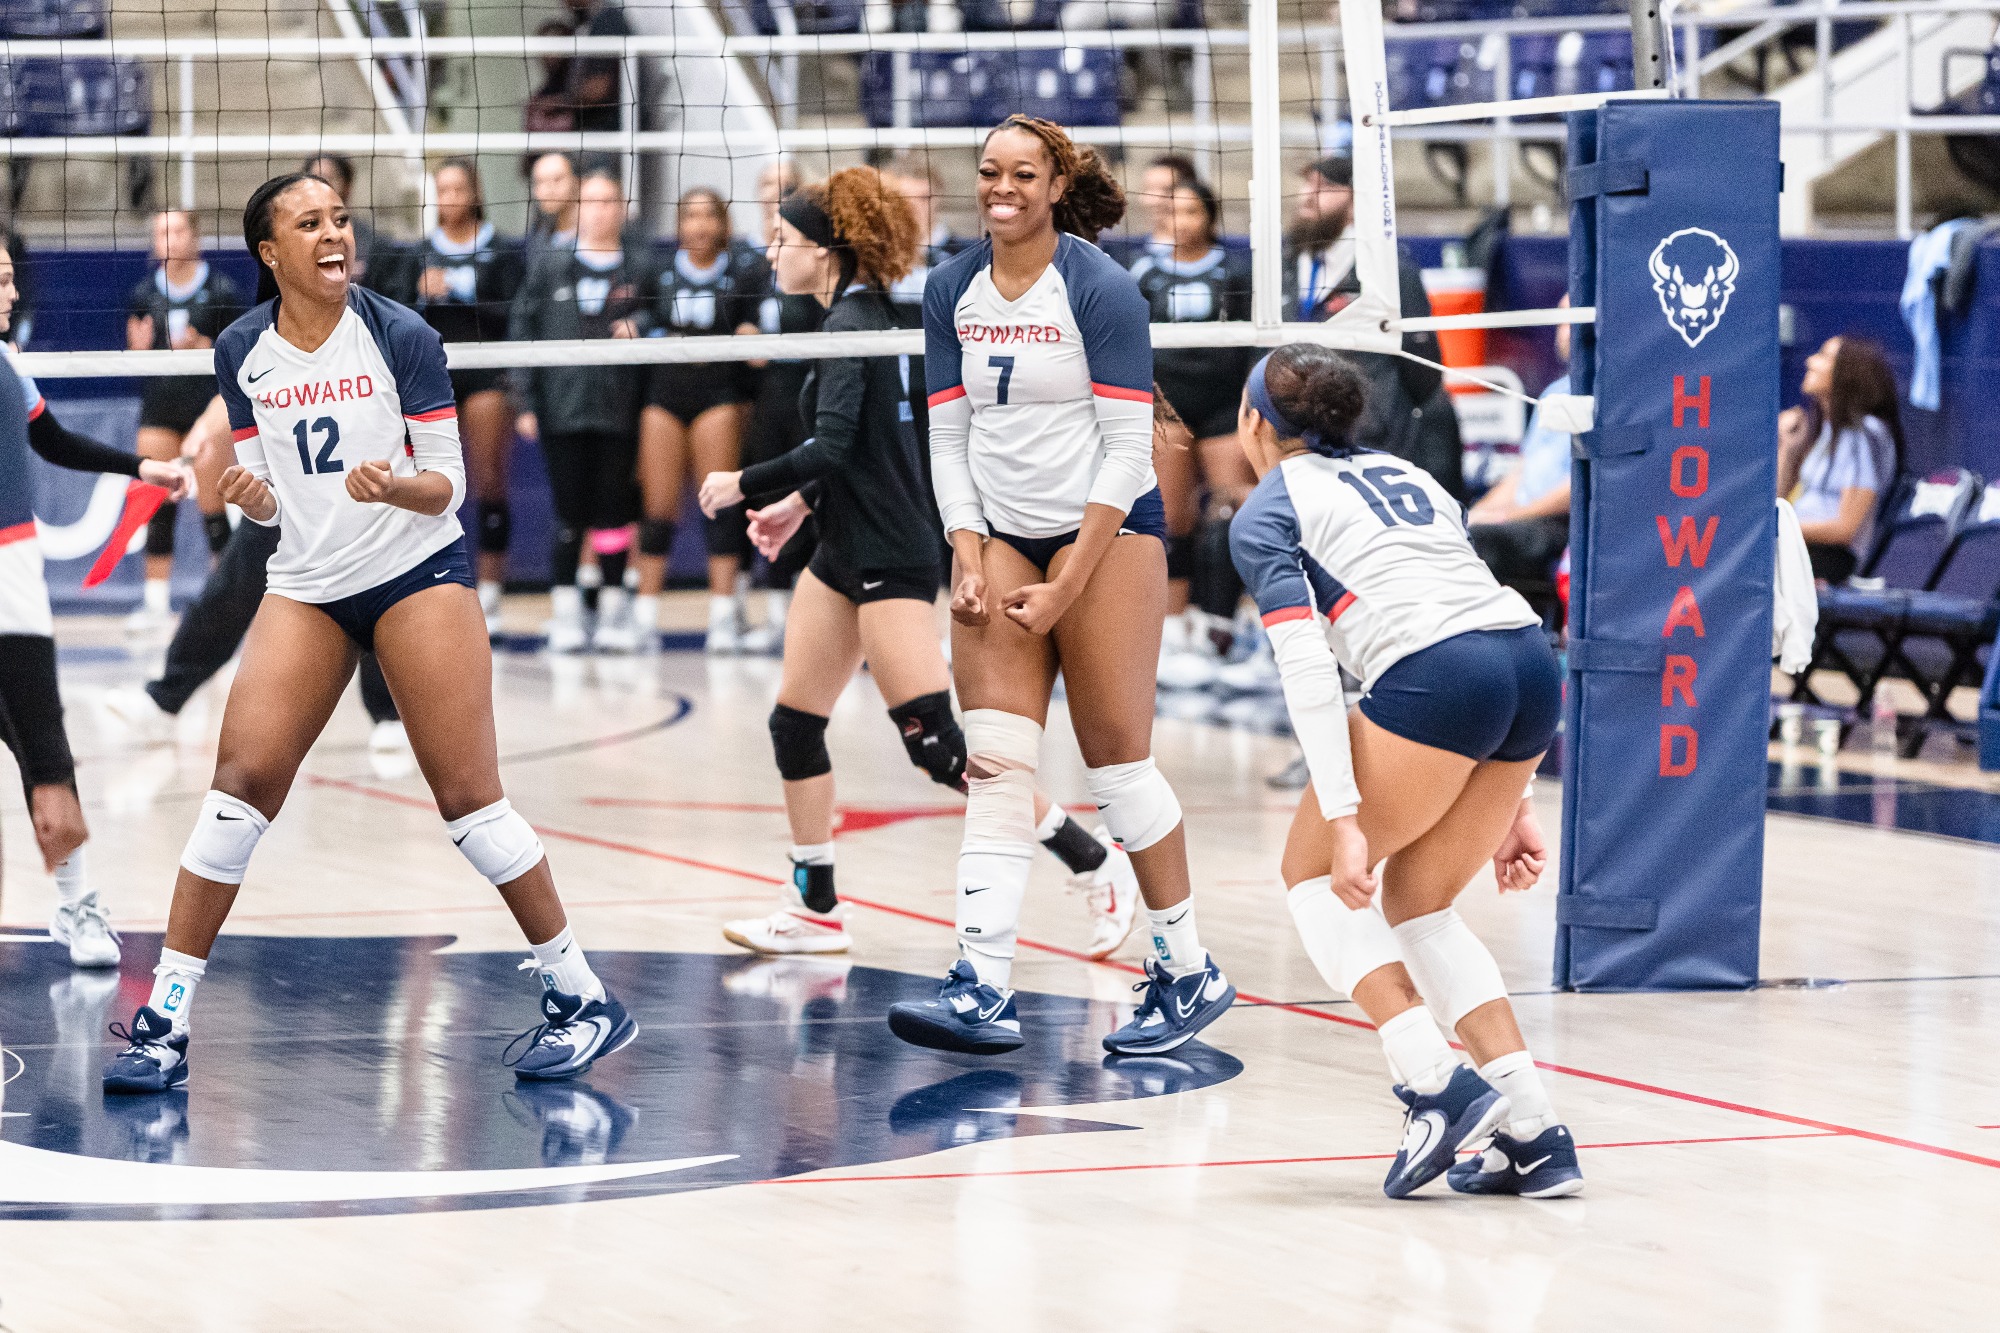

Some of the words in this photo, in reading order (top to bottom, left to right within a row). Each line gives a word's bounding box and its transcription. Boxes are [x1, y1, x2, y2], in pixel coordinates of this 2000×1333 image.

[1374, 81, 1392, 227] VOLLYBALLUSA.COM
[958, 324, 1060, 344] HOWARD
[257, 375, 373, 408] HOWARD
[988, 355, 1015, 405] 7
[292, 416, 344, 475] 12
[1337, 465, 1435, 527] 16
[1655, 375, 1720, 777] HOWARD
